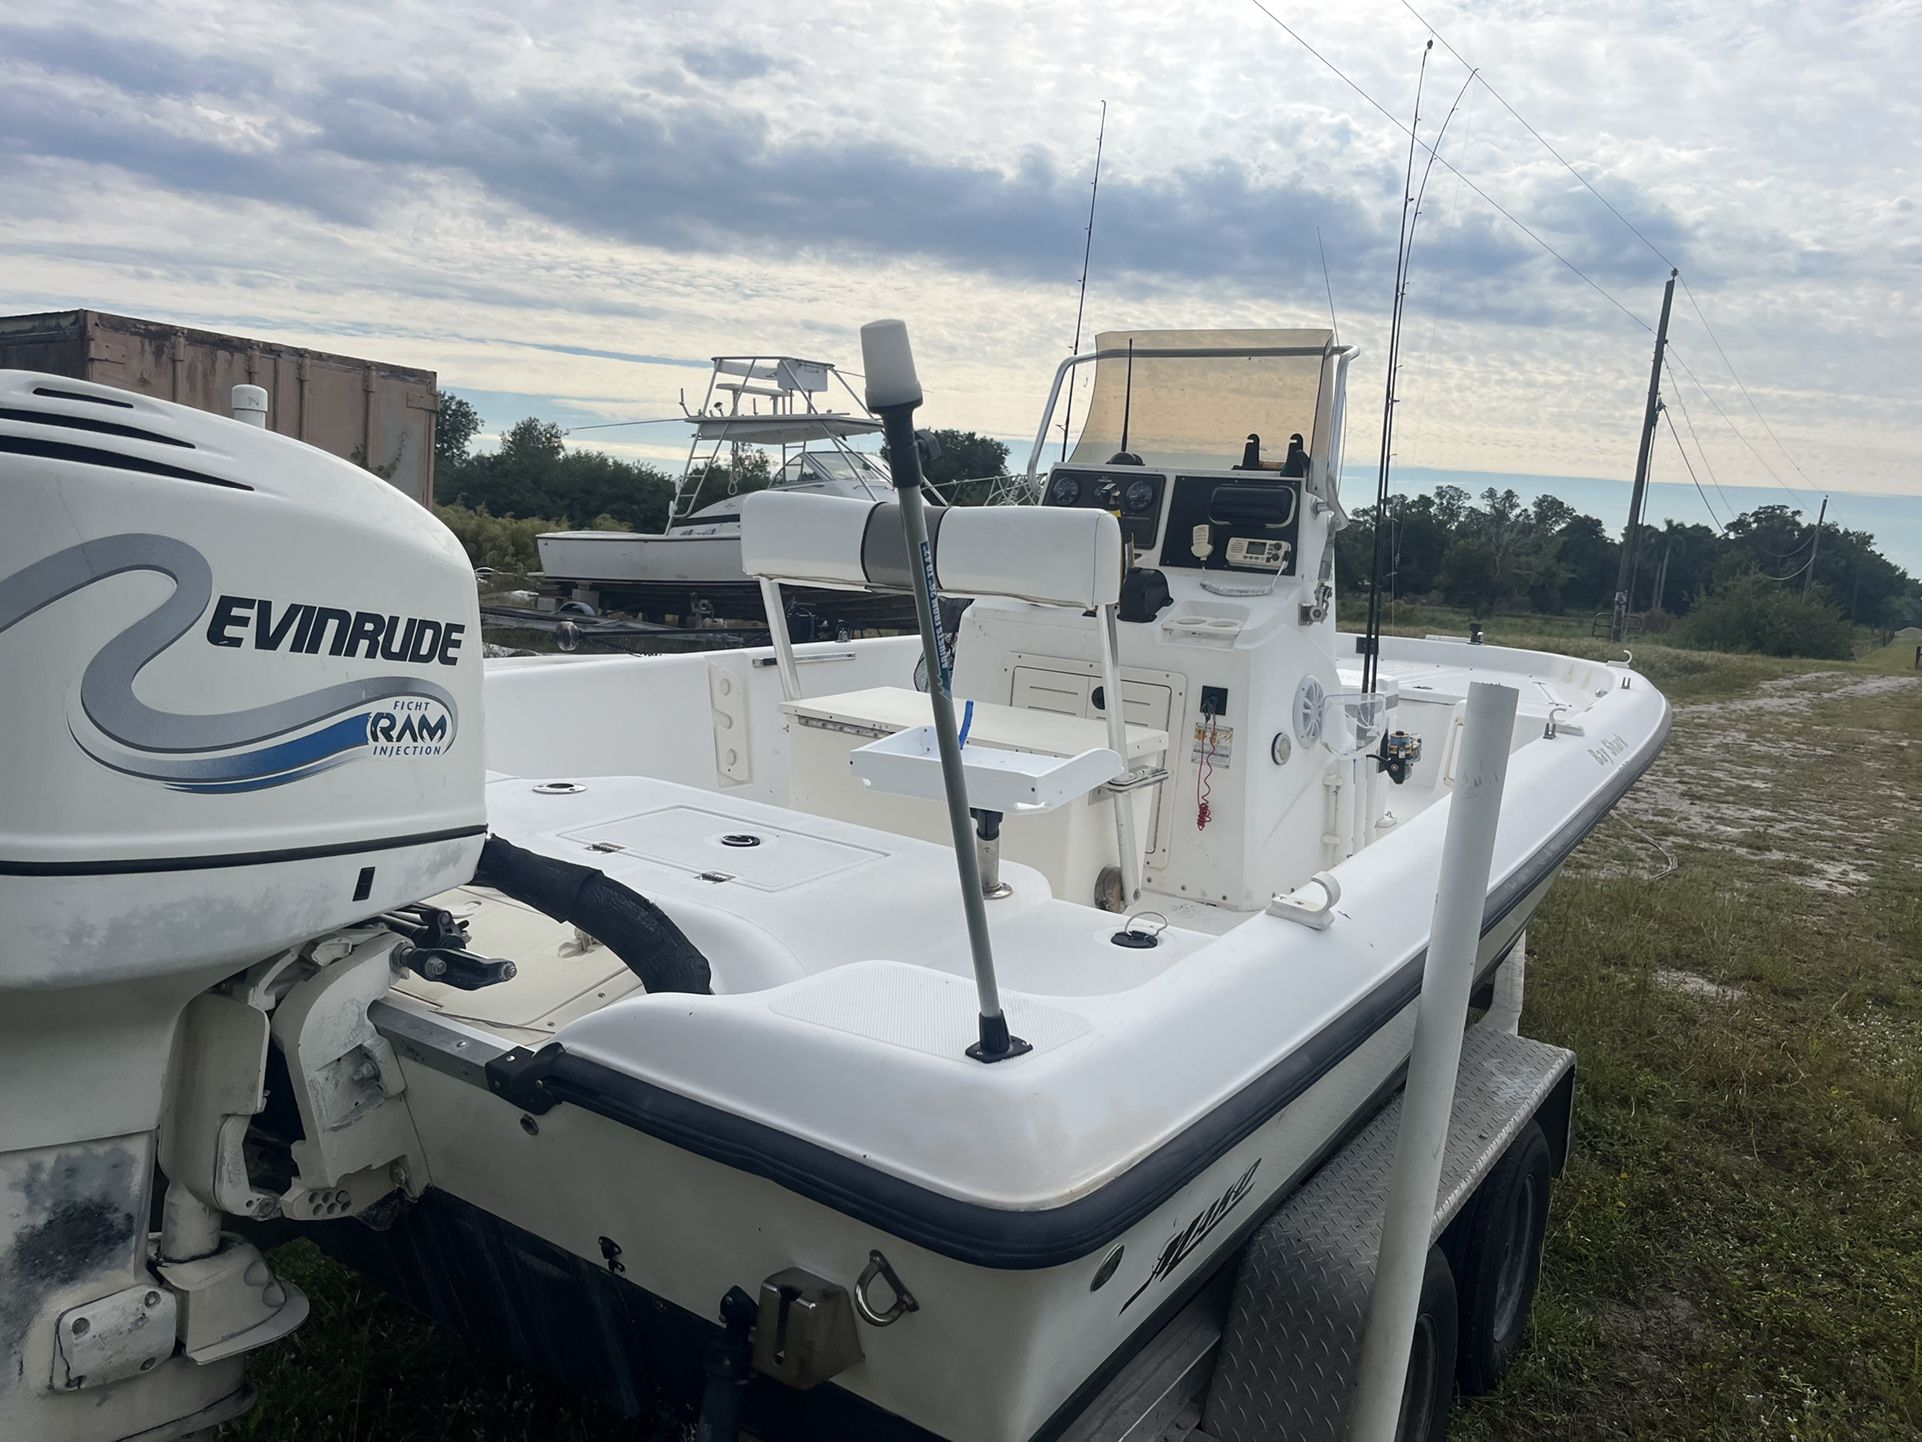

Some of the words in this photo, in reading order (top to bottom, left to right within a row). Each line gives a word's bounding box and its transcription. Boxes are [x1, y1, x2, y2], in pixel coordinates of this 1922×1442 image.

[931, 599, 942, 627] FROM
[206, 595, 465, 666] EVINRUDE
[393, 701, 430, 711] FICHT
[370, 712, 447, 743] RAM
[373, 746, 441, 757] INJECTION
[1587, 748, 1615, 766] Bay
